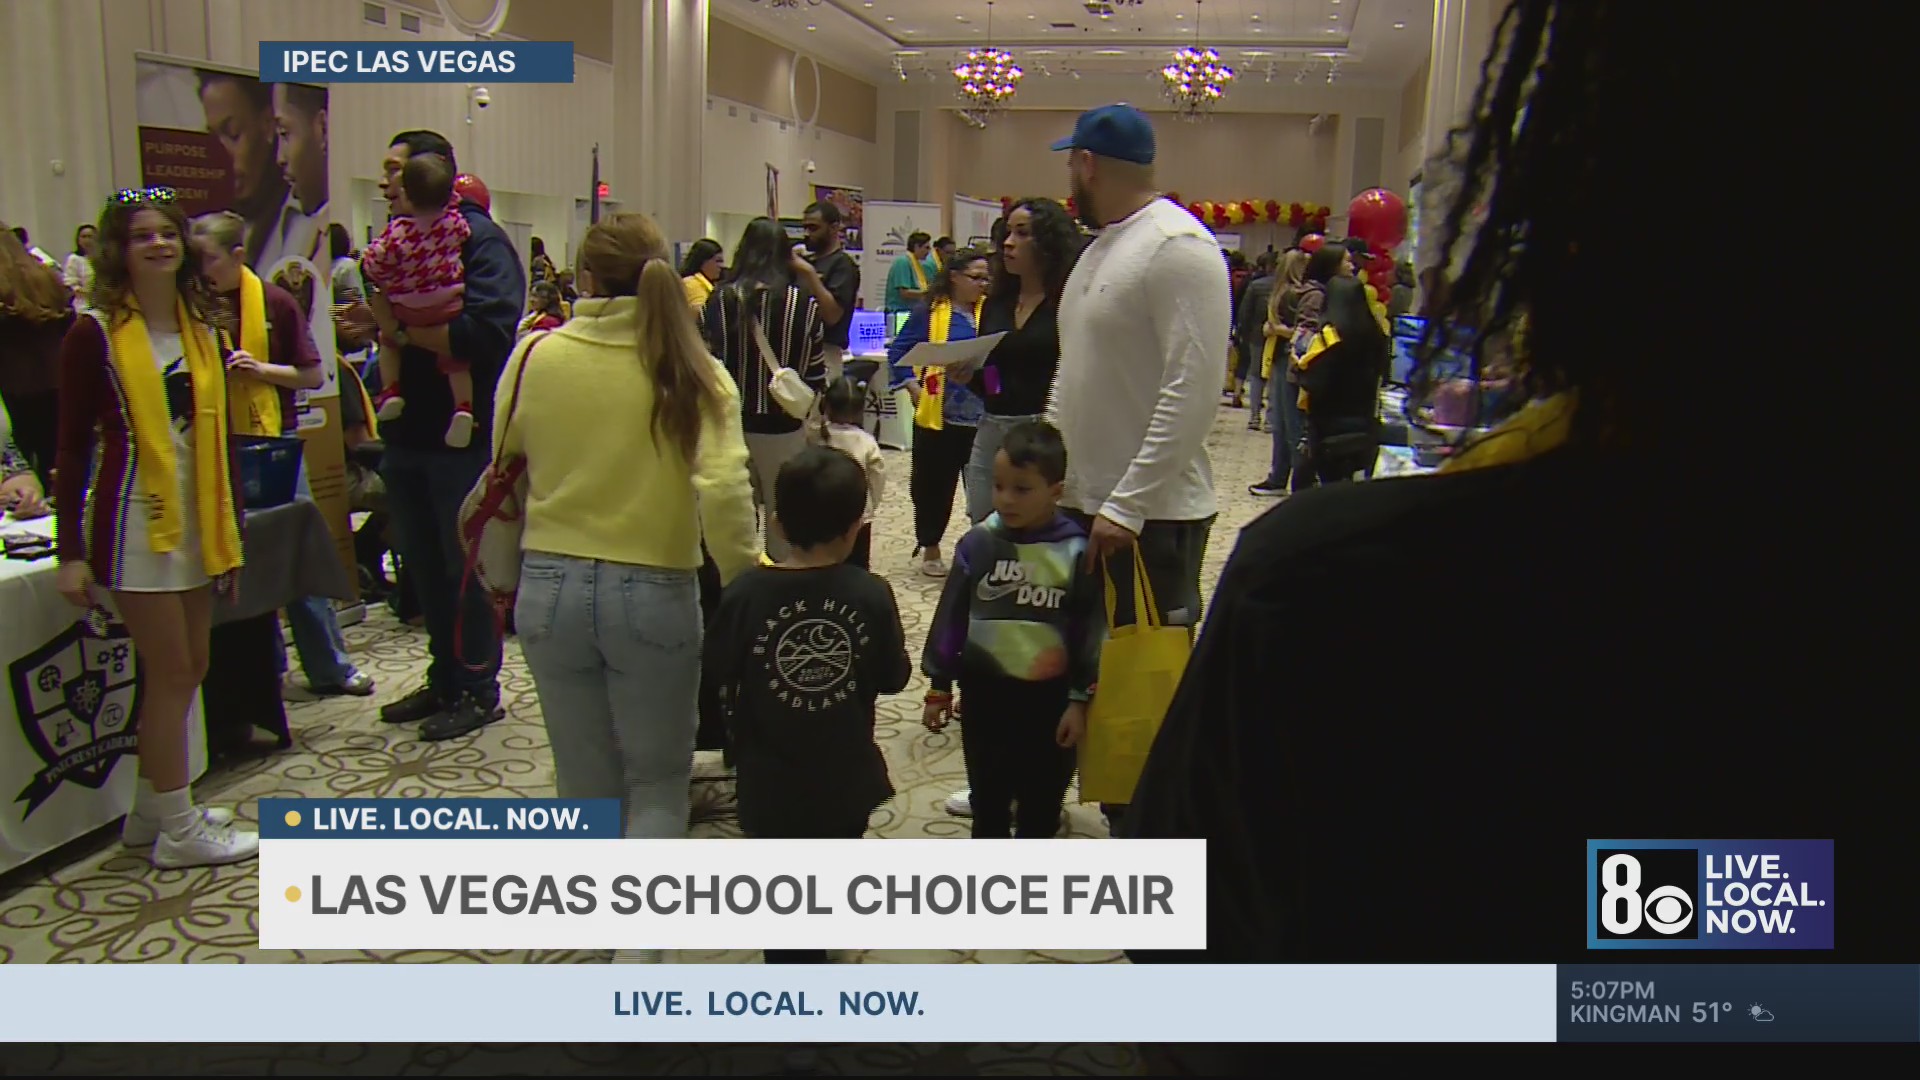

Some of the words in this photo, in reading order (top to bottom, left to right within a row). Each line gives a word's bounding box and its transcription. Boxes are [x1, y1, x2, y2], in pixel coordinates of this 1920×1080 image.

[144, 142, 207, 158] PURPOSE
[145, 164, 226, 179] LEADERSHIP
[752, 600, 808, 656] BLACK
[823, 598, 870, 646] HILLS
[768, 679, 857, 712] BADLAND
